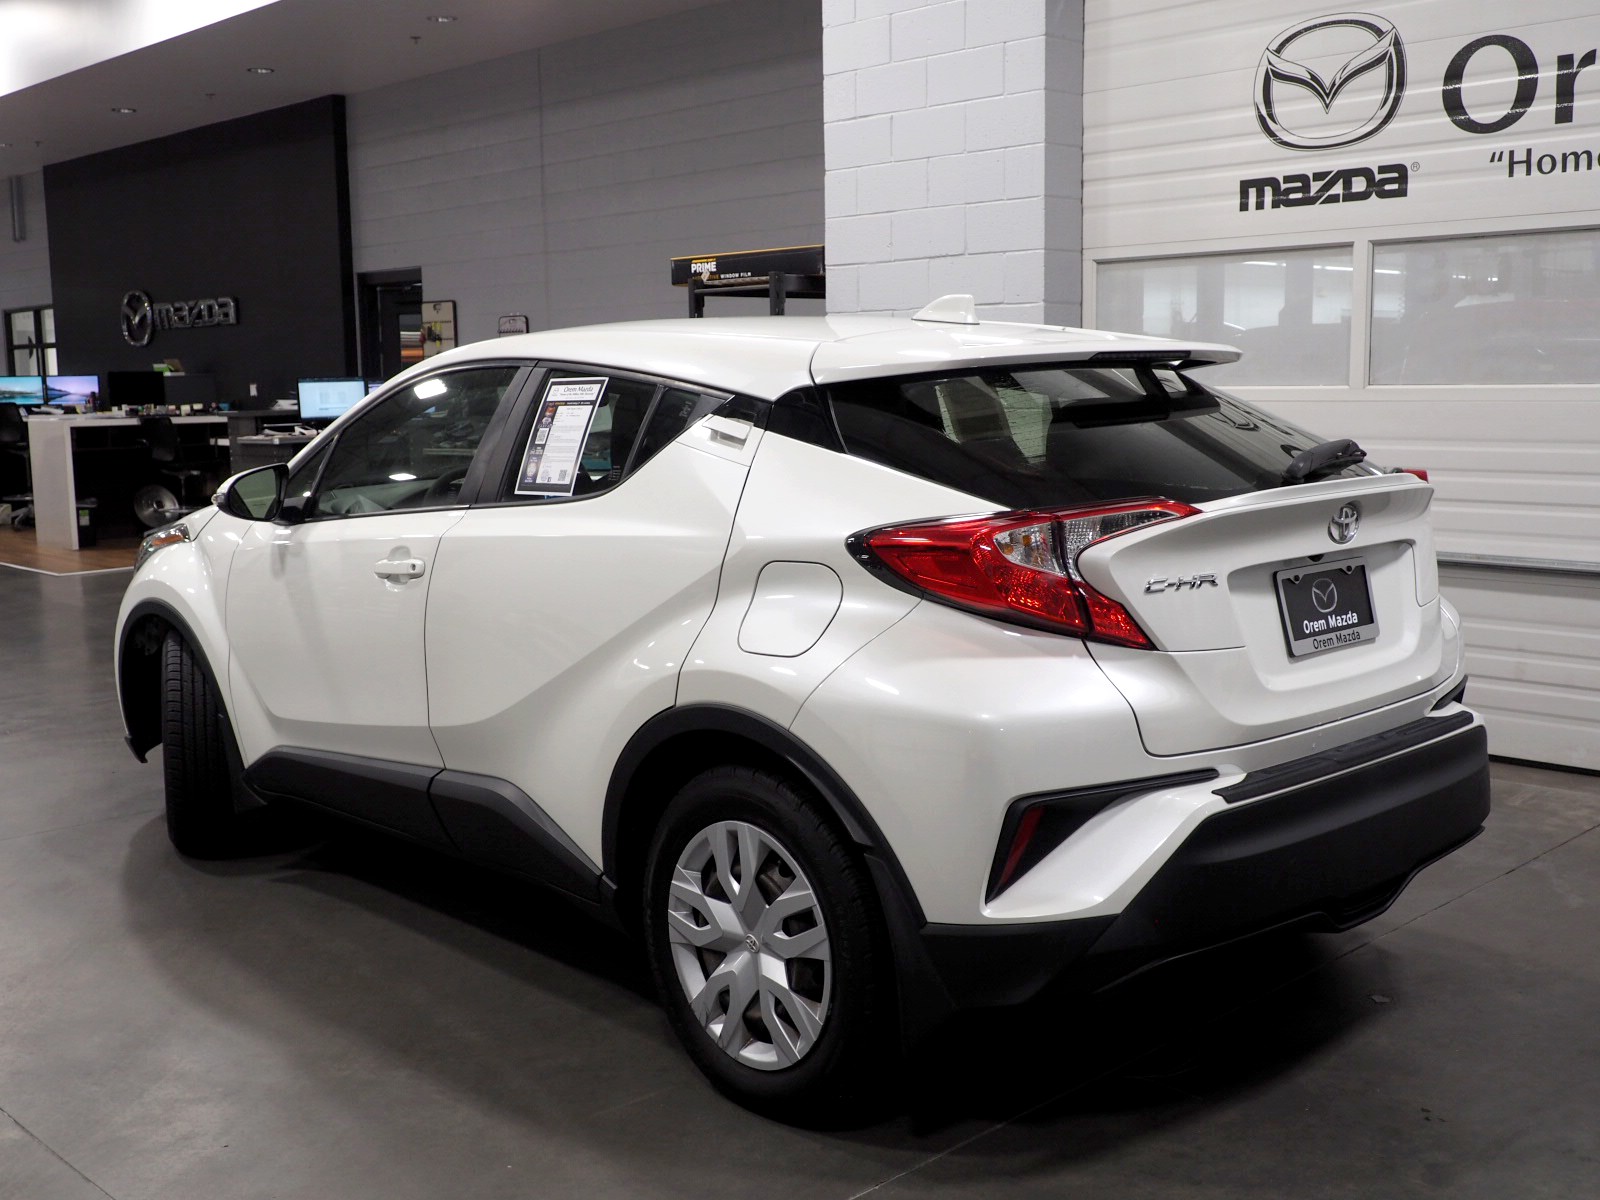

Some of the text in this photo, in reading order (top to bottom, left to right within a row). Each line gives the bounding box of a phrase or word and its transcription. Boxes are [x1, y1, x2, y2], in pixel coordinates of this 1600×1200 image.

[1442, 34, 1597, 134] Or
[1490, 148, 1600, 177] “Hom
[691, 262, 717, 273] PRIME
[1144, 573, 1218, 593] C-HR
[1303, 610, 1358, 634] Orem Mazda
[1312, 629, 1361, 650] Orem Mazda
